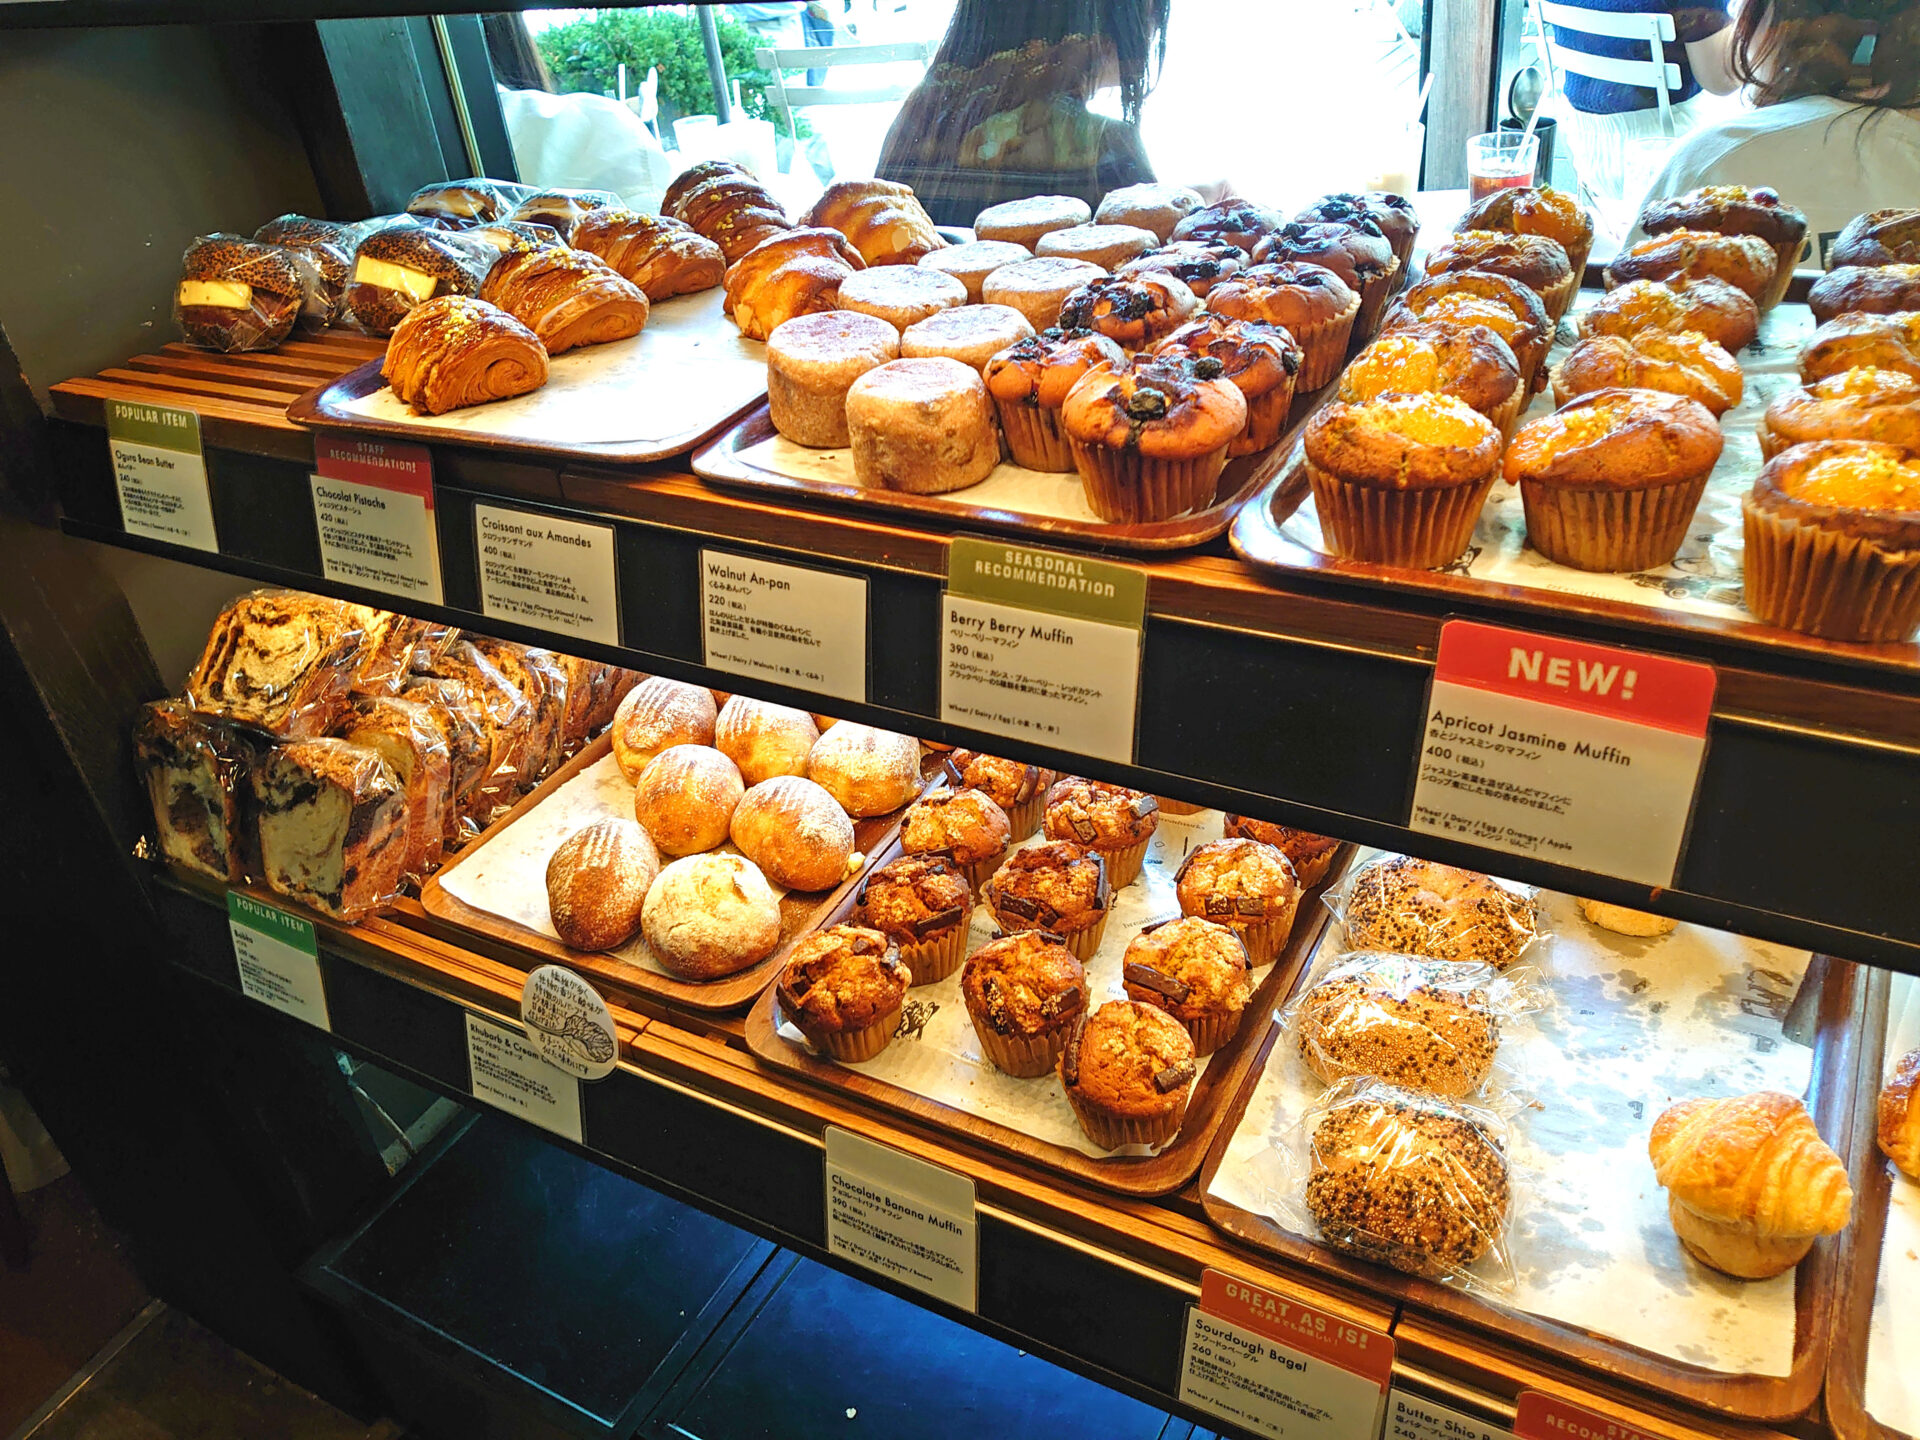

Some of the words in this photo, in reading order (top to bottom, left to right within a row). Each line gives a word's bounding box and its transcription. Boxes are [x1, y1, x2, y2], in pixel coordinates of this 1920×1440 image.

[115, 405, 158, 422] POPULAR
[162, 412, 186, 427] ITEM
[115, 449, 136, 462] Ogura
[137, 453, 154, 464] Bean
[155, 456, 174, 469] Butter
[357, 441, 385, 455] STAFF
[330, 449, 416, 473] RECOMMENDATION!
[316, 486, 351, 502] Chocolat
[353, 493, 385, 509] Pistache
[320, 512, 332, 522] 420
[481, 516, 522, 534] Croissant
[525, 528, 543, 538] aux
[546, 530, 591, 548] Amandes
[483, 545, 497, 555] 400
[1005, 551, 1083, 575] SEASONAL
[708, 563, 745, 581] Walnut
[749, 572, 790, 590] An-pan
[708, 580, 751, 595] くるみあんパン
[975, 560, 1113, 596] RECOMMENDATION
[708, 593, 725, 605] 220
[950, 610, 984, 631] Berry
[989, 617, 1025, 639] Berry
[1030, 626, 1073, 644] Muffin
[950, 629, 1019, 648] ベリーベリーマフィン
[949, 642, 968, 655] 390
[1509, 648, 1636, 698] NEW!
[1430, 729, 1540, 760] 杏とジャスミンのマフィン
[1431, 710, 1493, 734] Apricot
[1498, 725, 1566, 751] Jasmine
[1573, 741, 1630, 765] Muffin
[1426, 745, 1452, 759] 400
[1416, 806, 1441, 817] Wheat
[1448, 814, 1472, 826] Dairy
[1481, 822, 1497, 833] Egg
[1506, 828, 1538, 843] Orange
[1547, 839, 1572, 850] Apple
[236, 898, 278, 923] POPULAR
[281, 914, 305, 933] ITEM
[470, 1023, 502, 1044] Rhubarb
[504, 1038, 510, 1047] &
[513, 1042, 539, 1059] Cream
[831, 1174, 881, 1202] Chocolate
[884, 1196, 924, 1220] Banana
[928, 1214, 962, 1235] Muffin
[832, 1195, 847, 1208] 390
[832, 1186, 902, 1219] チョコレートバナナマフィン
[1226, 1283, 1289, 1316] GREAT
[1300, 1313, 1326, 1331] AS
[1337, 1326, 1367, 1348] IS!
[1192, 1342, 1211, 1356] 260
[1195, 1319, 1264, 1354] Sourdough
[1269, 1349, 1306, 1372] Bagel
[1397, 1401, 1439, 1425] Butter
[1444, 1420, 1476, 1439] Shio
[1394, 1426, 1416, 1440] 240
